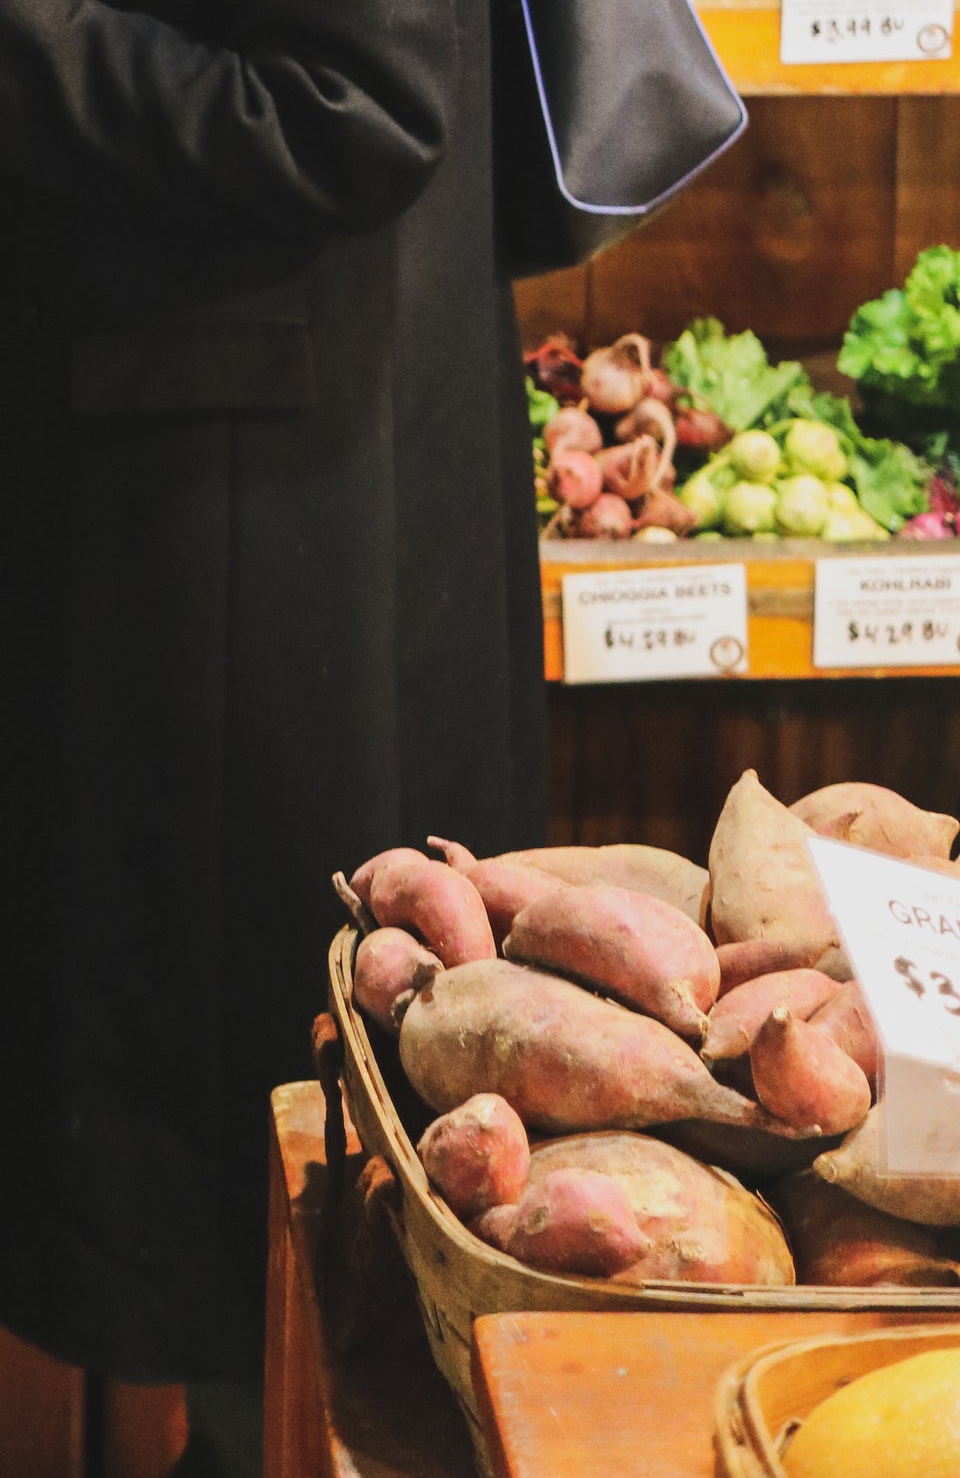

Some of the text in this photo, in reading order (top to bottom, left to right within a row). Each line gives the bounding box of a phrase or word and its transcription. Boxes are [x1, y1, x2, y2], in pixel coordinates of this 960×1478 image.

[579, 582, 732, 604] CHIOGGIA BEETS
[859, 577, 952, 591] KOHLRABI
[888, 900, 960, 940] GRA
